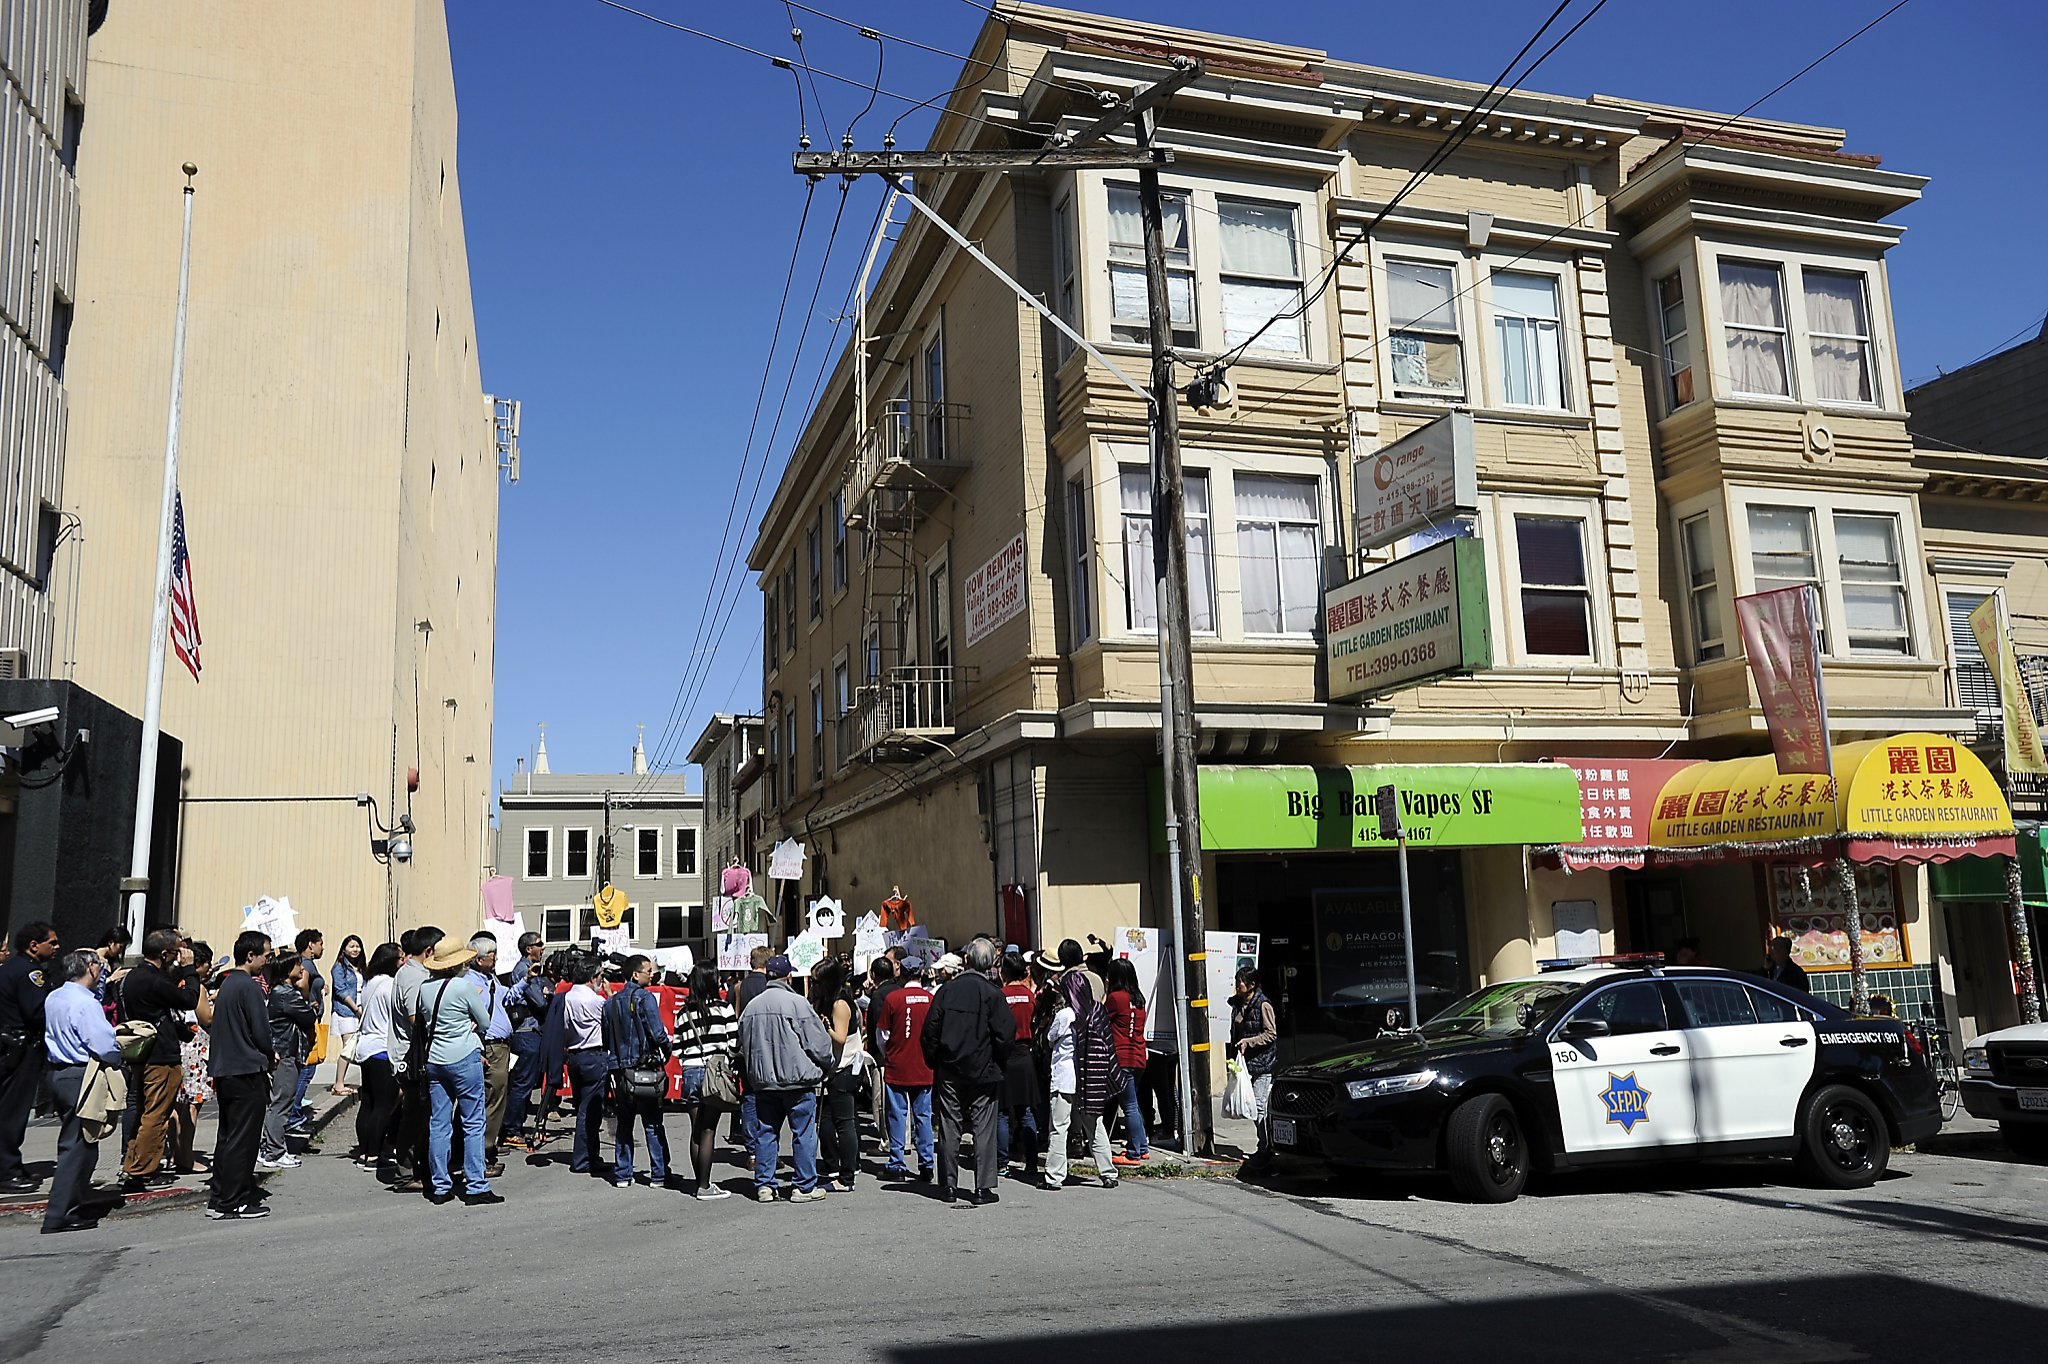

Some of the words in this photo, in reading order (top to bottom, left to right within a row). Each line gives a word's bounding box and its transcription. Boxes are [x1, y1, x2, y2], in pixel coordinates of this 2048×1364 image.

[967, 571, 983, 597] NOW
[987, 538, 1022, 581] RENTING
[967, 592, 984, 612] Vallejo
[987, 575, 1004, 597] Emery
[972, 608, 985, 631] (415)
[1332, 634, 1358, 659] LITTLE
[1359, 621, 1392, 649] GARDEN
[1394, 606, 1450, 639] RESTAURANT
[1347, 641, 1436, 682] TEL:399-0368
[1887, 746, 1957, 775] 麗園
[1882, 778, 1974, 801] 港式茶餐廳
[1287, 790, 1324, 820] Big
[1338, 792, 1379, 816] Ban
[1401, 790, 1460, 818] Vapes
[1472, 790, 1493, 814] SF
[1861, 808, 1893, 823] LITTLE
[1895, 808, 1935, 822] GARDEN
[1938, 807, 1998, 822] RESTAURANT
[1667, 823, 1699, 838] LITTLE
[1701, 819, 1745, 836] GARDEN
[1747, 811, 1824, 833] RESTAURANT
[1325, 899, 1403, 914] AVAILABLE
[1346, 932, 1405, 941] PARAGON
[1819, 1032, 1883, 1045] EMERGENCY
[1885, 1032, 1900, 1044] 911
[1555, 1050, 1578, 1063] 150
